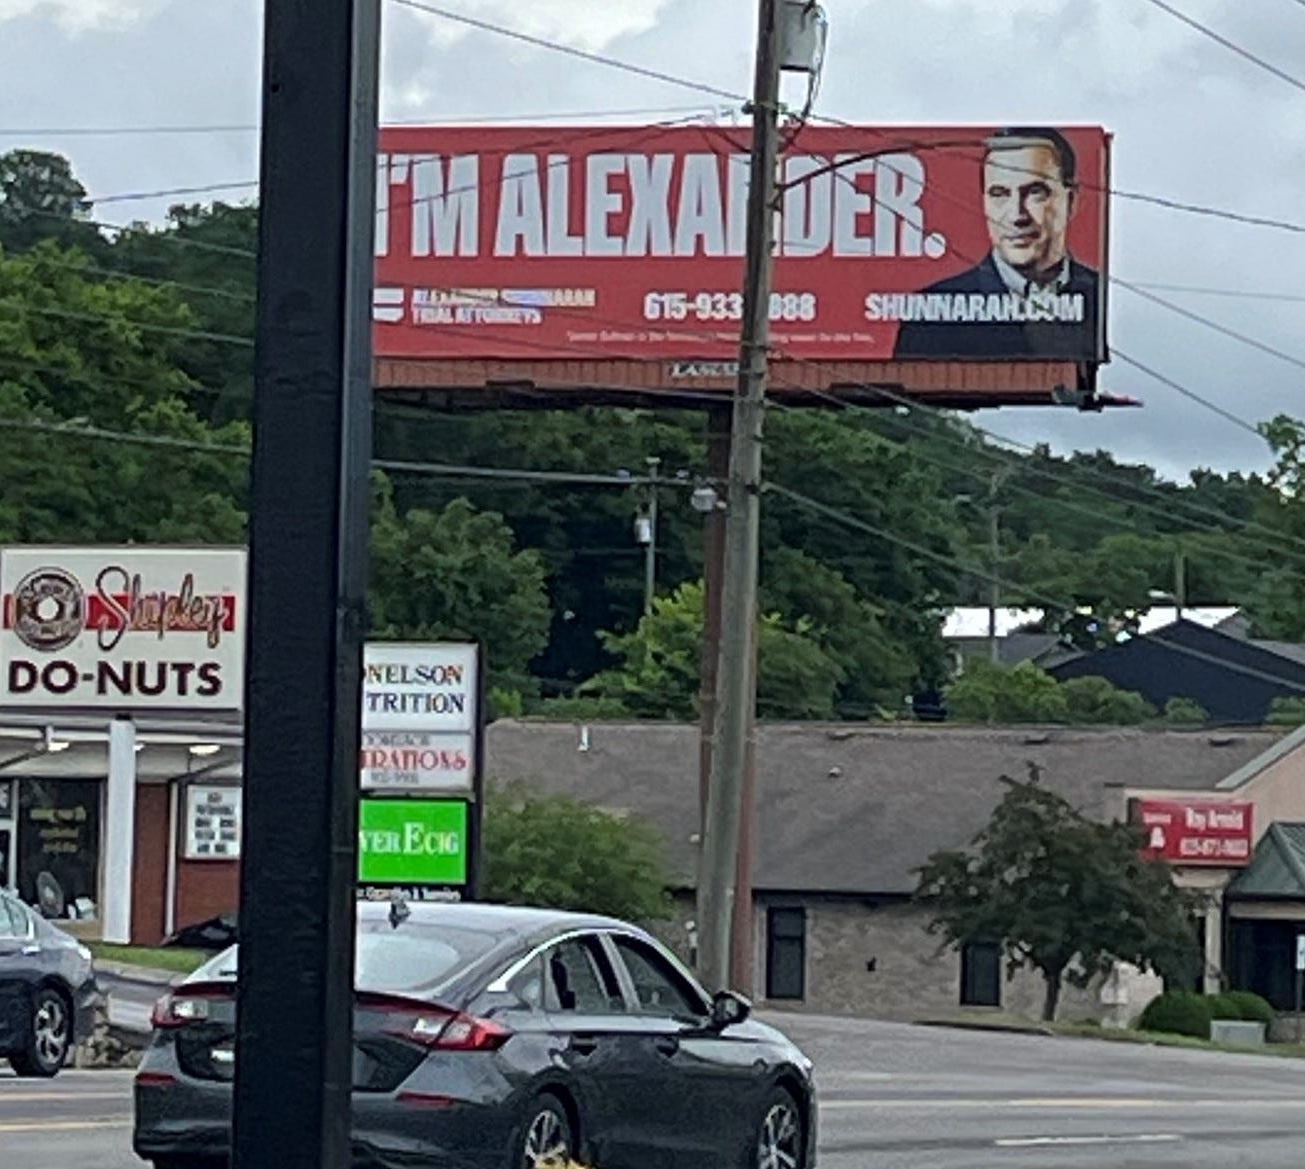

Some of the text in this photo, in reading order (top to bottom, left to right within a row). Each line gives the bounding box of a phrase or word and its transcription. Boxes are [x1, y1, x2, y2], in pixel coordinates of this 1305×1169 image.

[643, 291, 816, 322] 615-933888
[864, 292, 1085, 322] SHUNNARAH.COM
[7, 660, 223, 697] DO-NUTS
[364, 663, 463, 686] NELSON
[366, 692, 465, 714] TRITION
